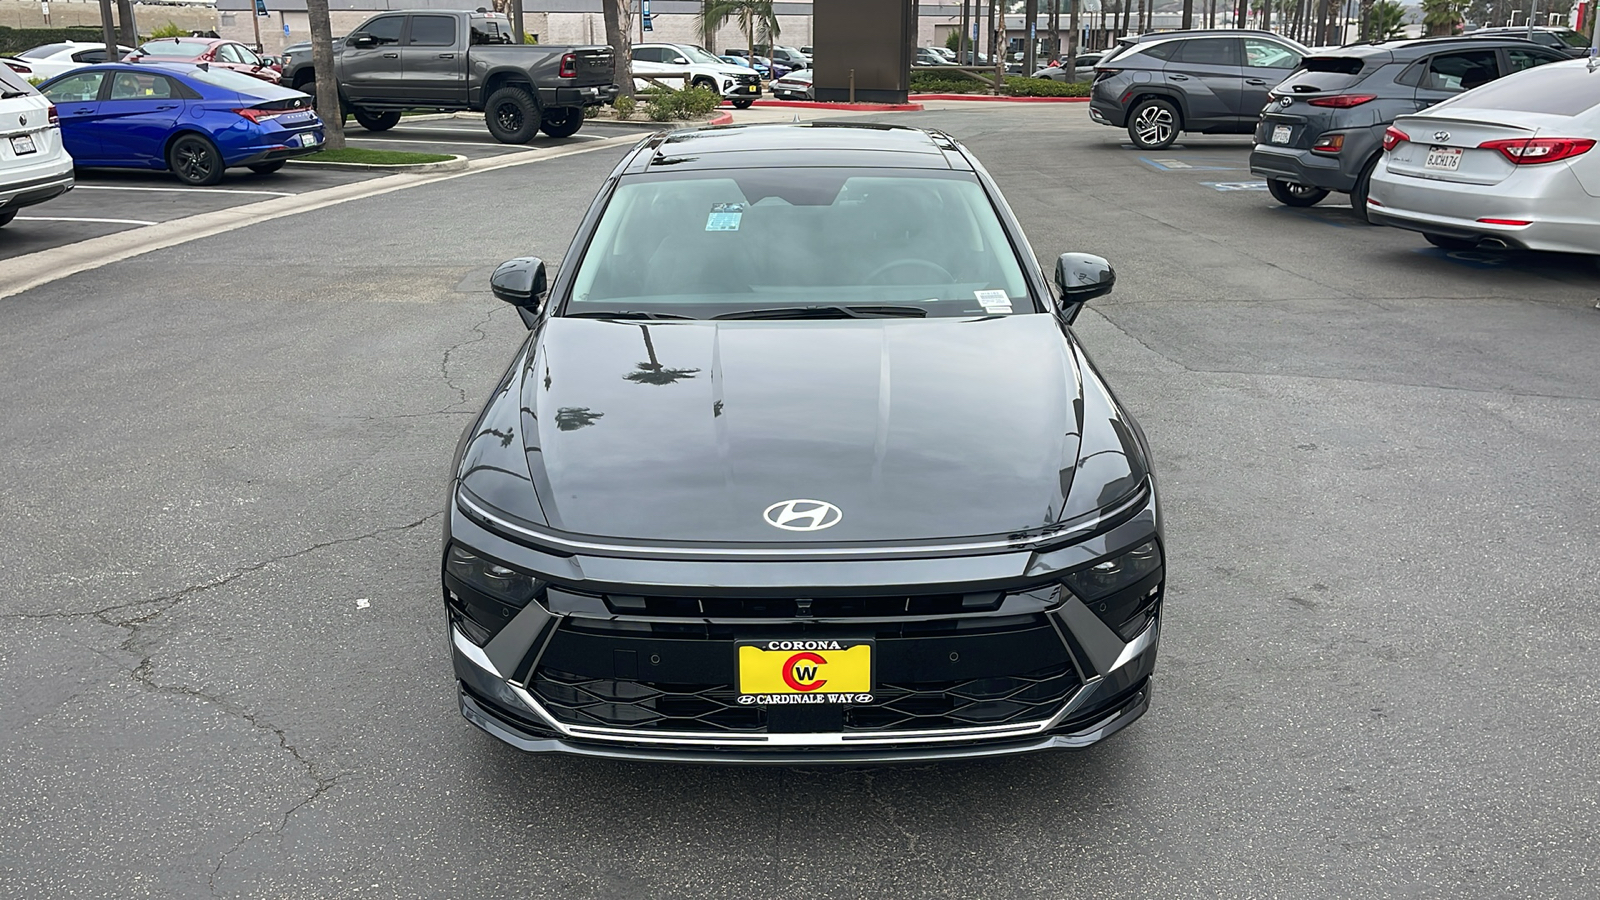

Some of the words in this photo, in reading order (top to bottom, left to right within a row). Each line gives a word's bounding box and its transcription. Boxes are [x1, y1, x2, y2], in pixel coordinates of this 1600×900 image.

[768, 640, 841, 650] CORONA
[756, 693, 826, 705] CARDINALE
[827, 693, 855, 704] WAY
